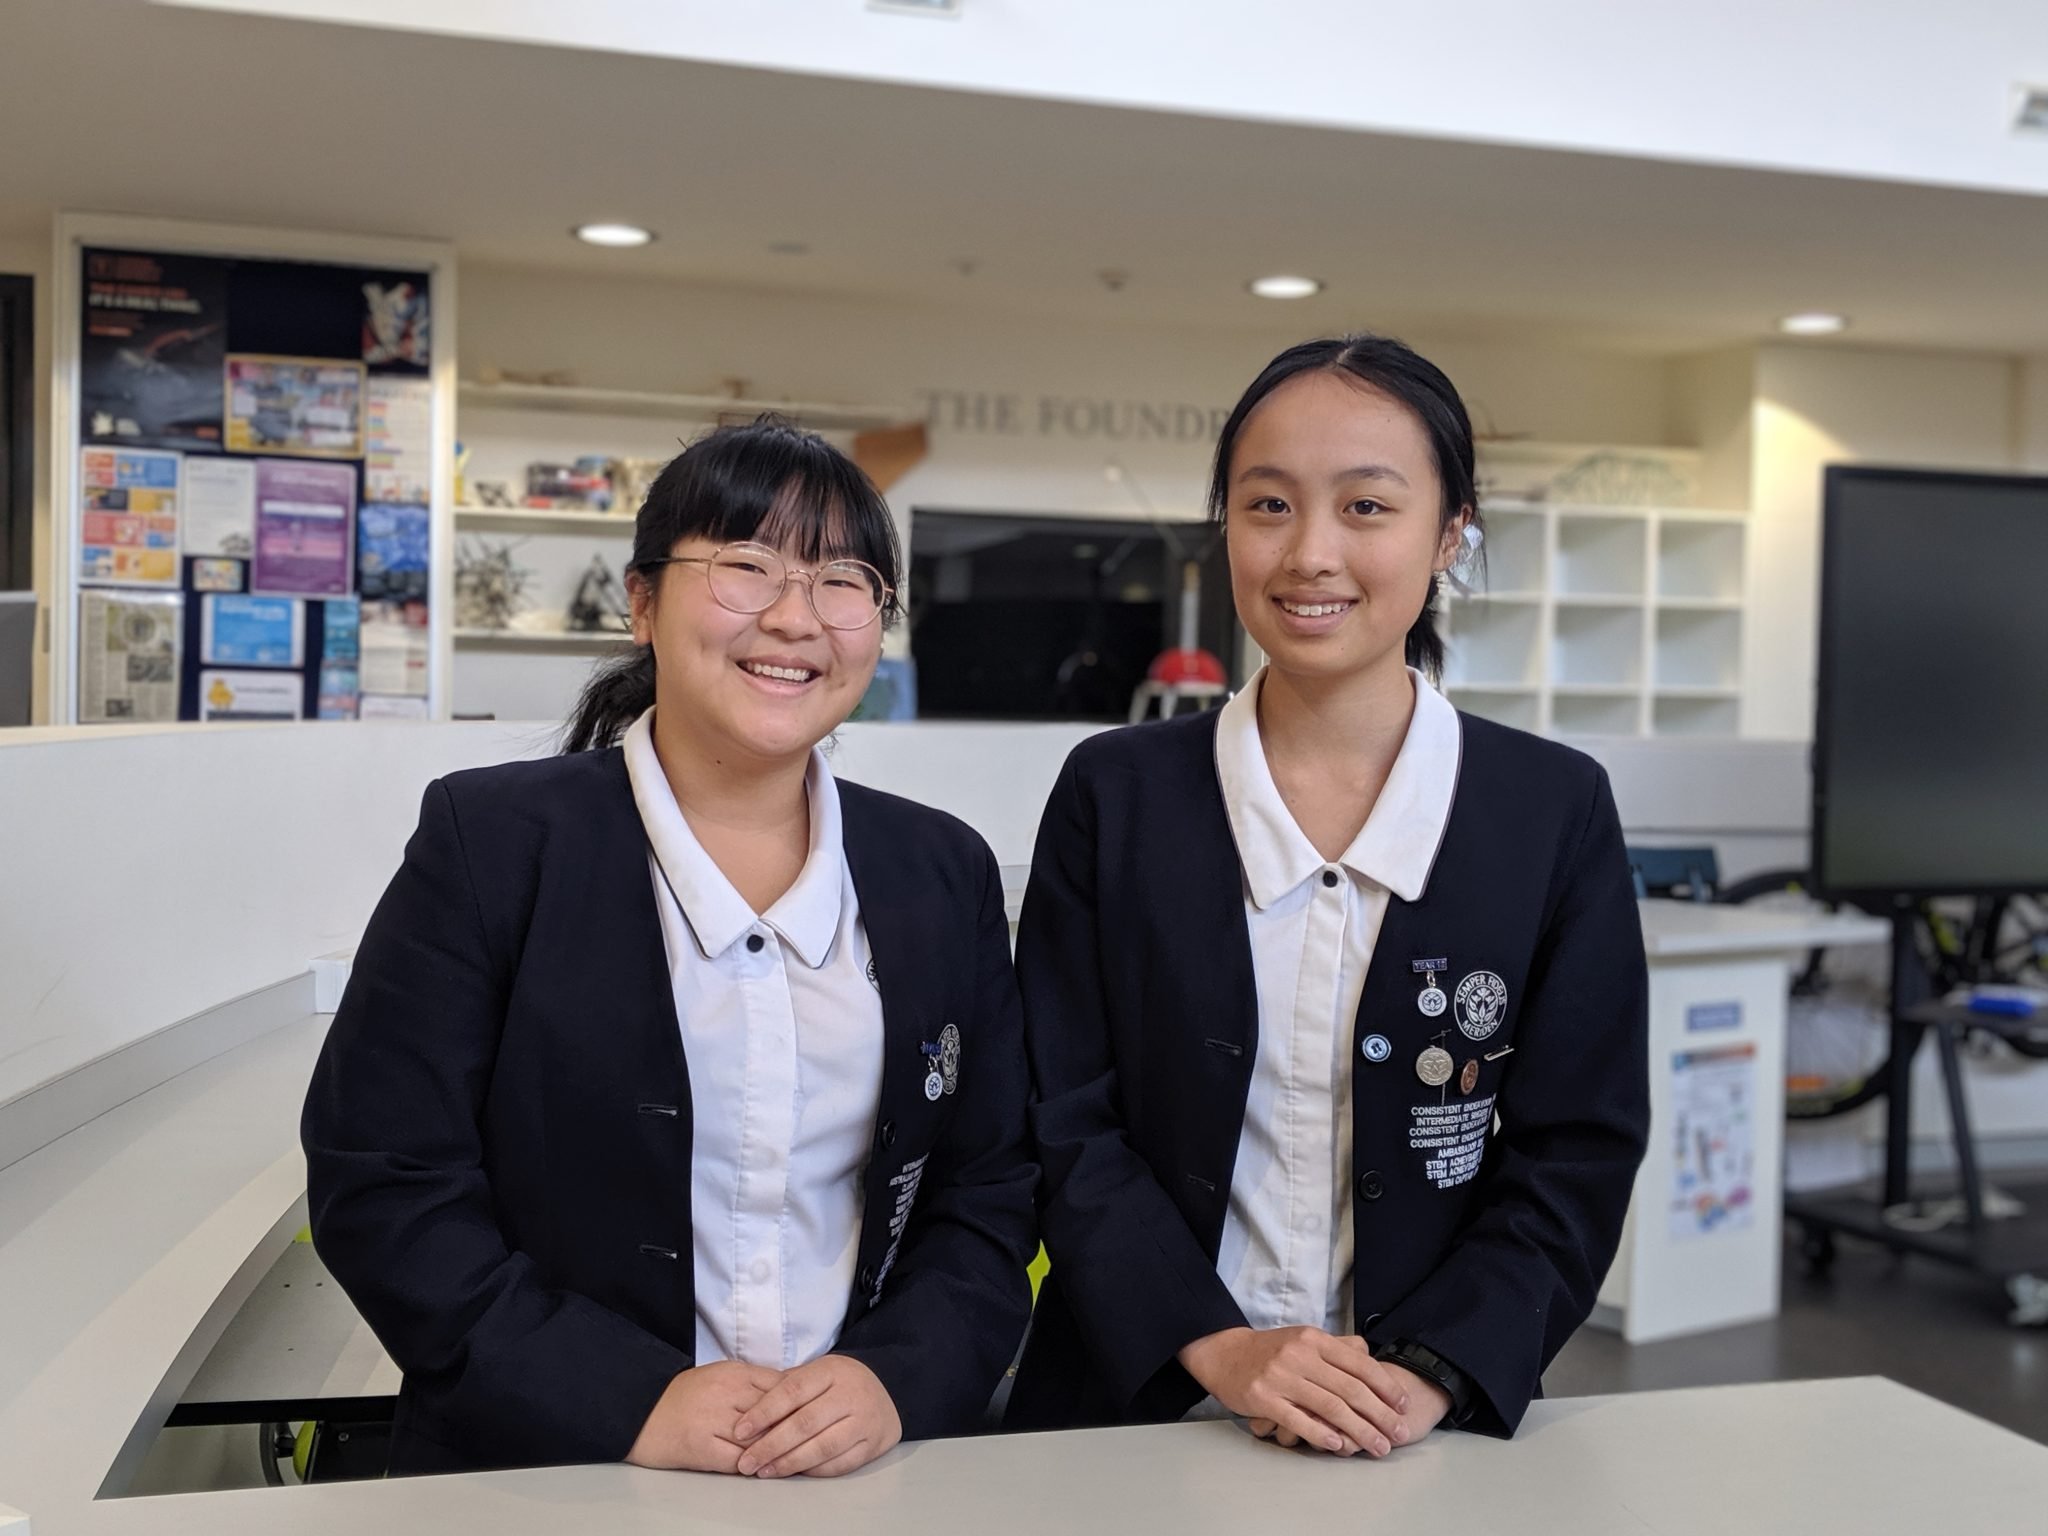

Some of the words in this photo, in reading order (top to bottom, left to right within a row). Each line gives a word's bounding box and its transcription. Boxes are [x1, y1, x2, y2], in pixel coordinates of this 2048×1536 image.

[919, 389, 1023, 436] THE
[1038, 396, 1234, 443] FOUNDR
[1414, 960, 1435, 970] YEAR
[1457, 974, 1486, 1005] SEMPER
[1488, 975, 1506, 1005] FIDELIS
[1462, 1019, 1497, 1037] MERIDEN
[1411, 1105, 1462, 1115] CONSISTENT
[1416, 1113, 1469, 1126] INTERMEDIATE
[1409, 1124, 1459, 1137] CONSISTENT
[1410, 1135, 1460, 1148] CONSISTENT
[1425, 1159, 1447, 1170] STEM
[1426, 1169, 1447, 1180] STEM
[1437, 1178, 1454, 1189] STEM
